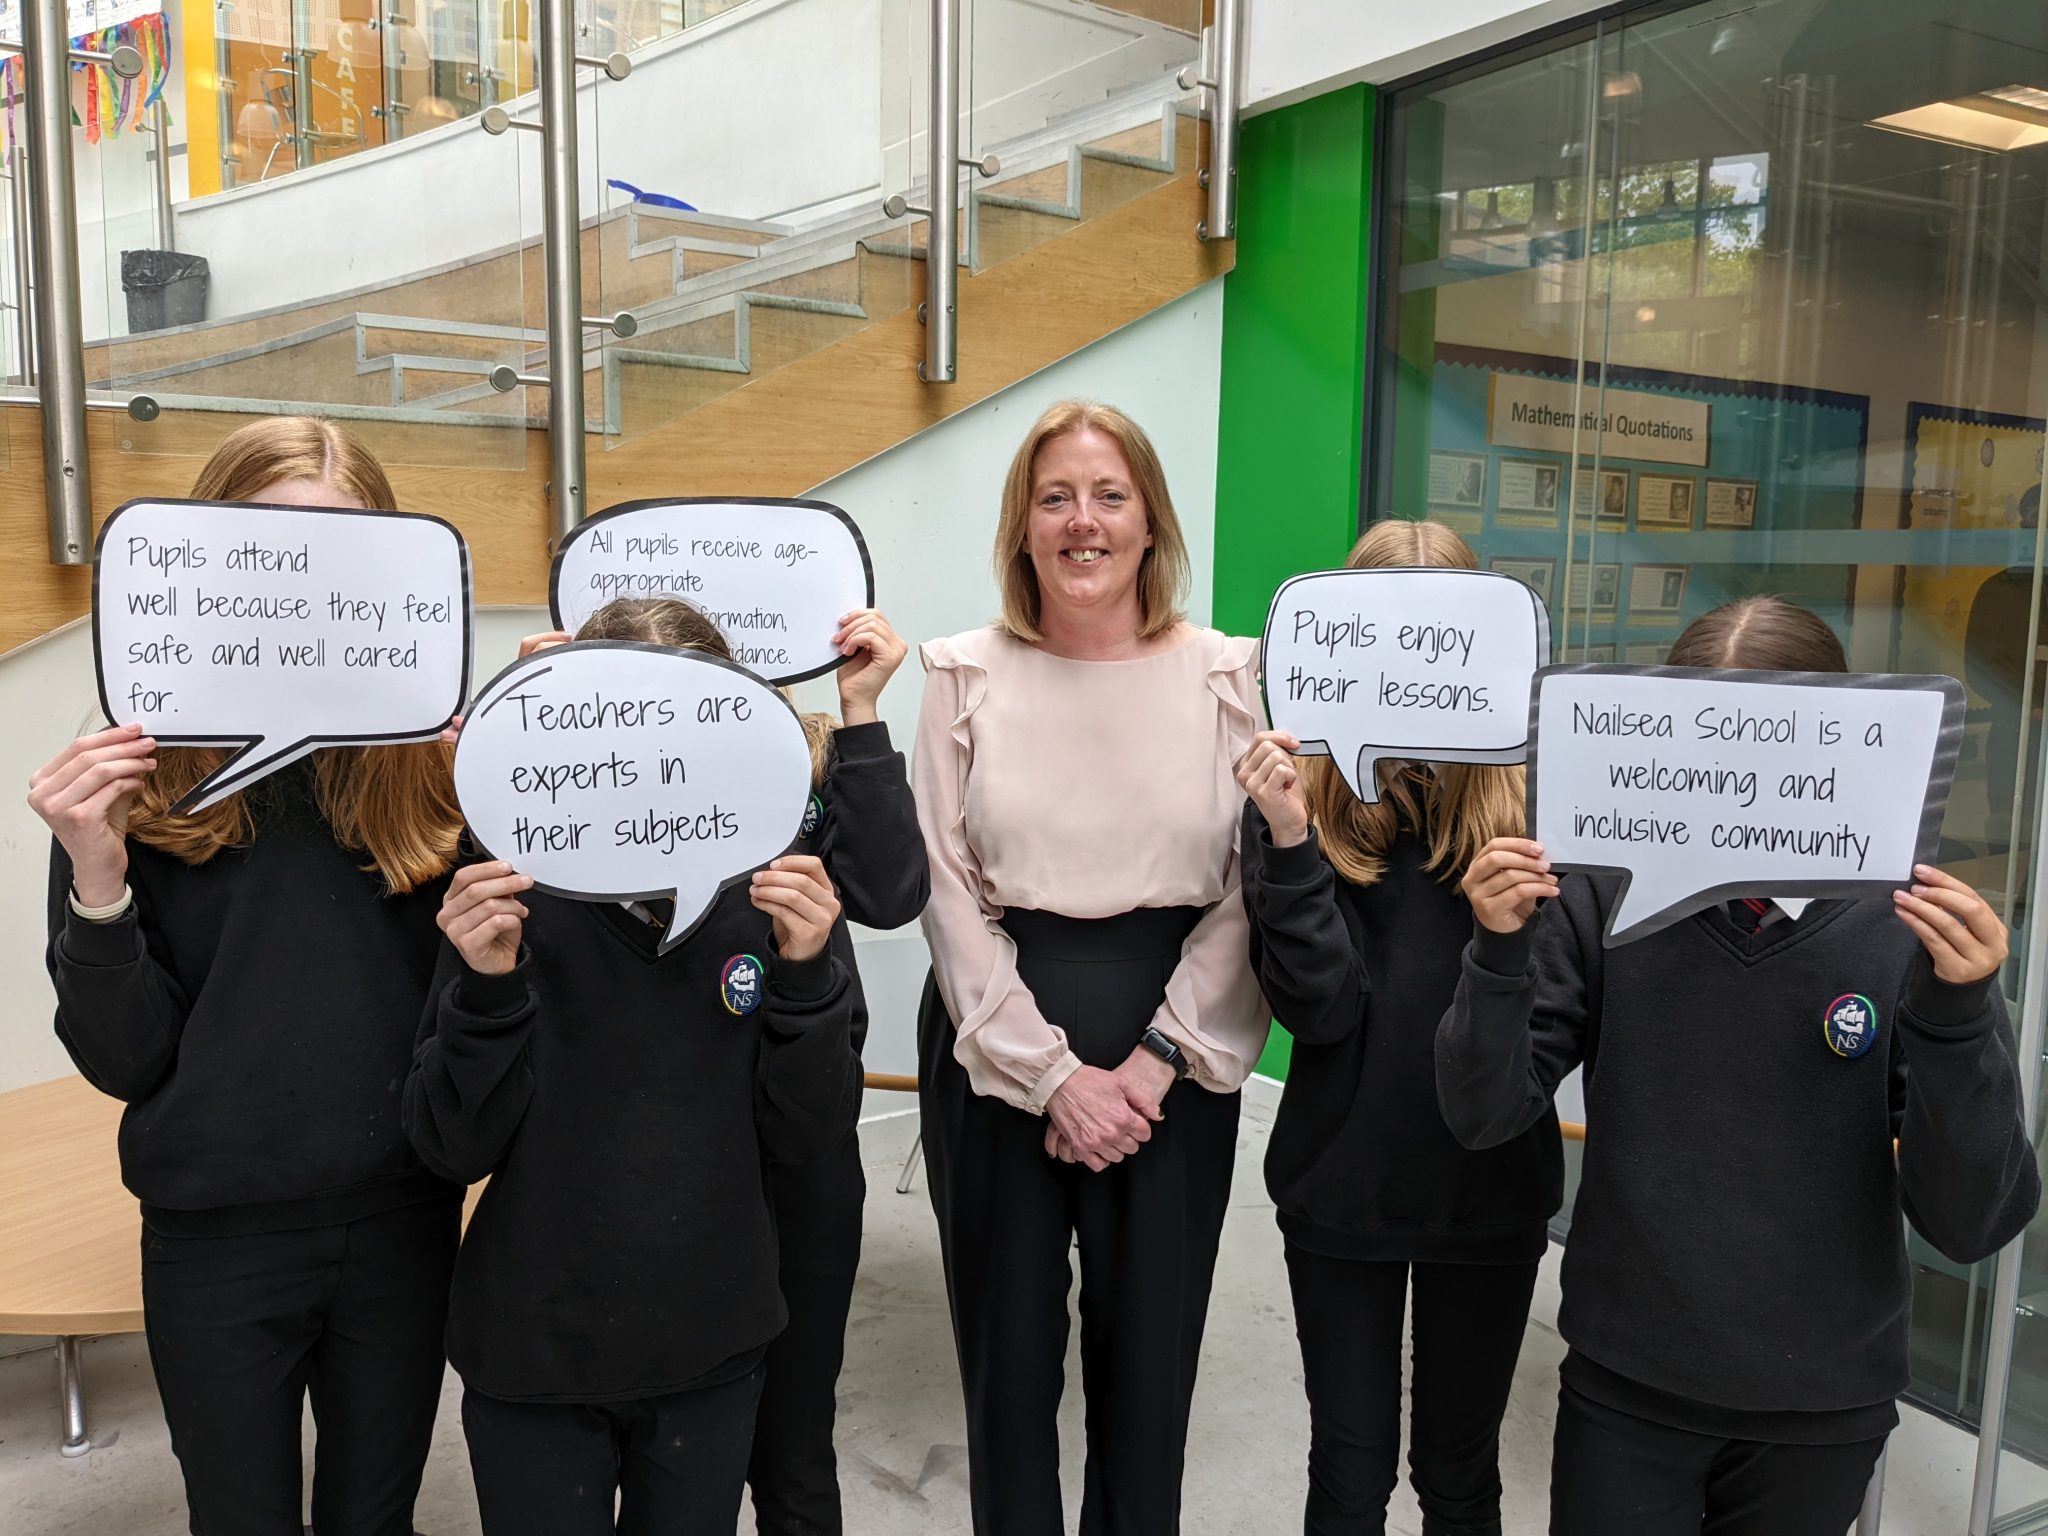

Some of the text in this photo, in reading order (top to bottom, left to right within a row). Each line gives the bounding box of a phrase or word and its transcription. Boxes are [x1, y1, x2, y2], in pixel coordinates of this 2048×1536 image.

[1616, 415, 1694, 442] Quotations
[127, 536, 308, 578] Pupils attend
[589, 529, 819, 568] All pupils receive age-
[590, 569, 705, 598] appropriate
[127, 586, 451, 633] well because they feel
[128, 634, 417, 670] safe and well cared
[1293, 609, 1475, 668] Pupils enjoy
[127, 682, 179, 713] for.
[1285, 665, 1494, 713] their lessons.
[505, 691, 752, 732] Teachers are
[1573, 701, 1883, 748] Nailsea School is a
[509, 748, 686, 805] experts in
[1609, 758, 1836, 808] welcoming and
[511, 803, 739, 856] their subjects
[1574, 805, 1871, 872] inclusive community
[733, 993, 754, 1010] NS
[1836, 1033, 1860, 1050] NS
